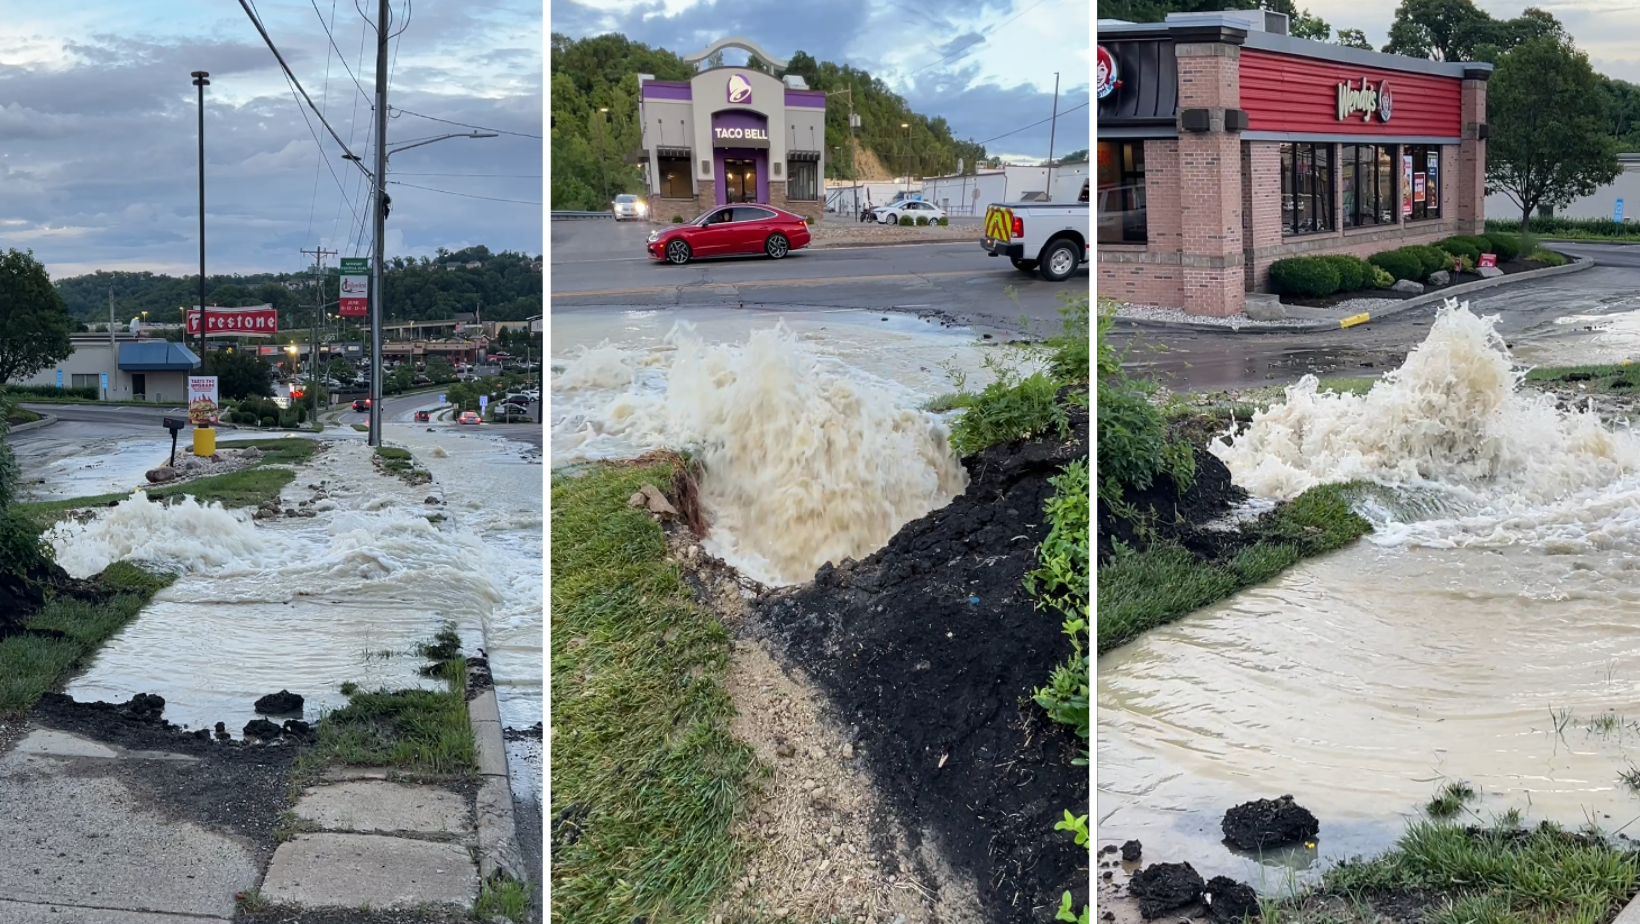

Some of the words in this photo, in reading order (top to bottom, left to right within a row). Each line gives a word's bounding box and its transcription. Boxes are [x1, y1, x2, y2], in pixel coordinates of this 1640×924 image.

[1338, 76, 1377, 122] Wendy's
[715, 128, 743, 139] TACO
[744, 128, 768, 140] BELL
[189, 313, 275, 331] Frestone
